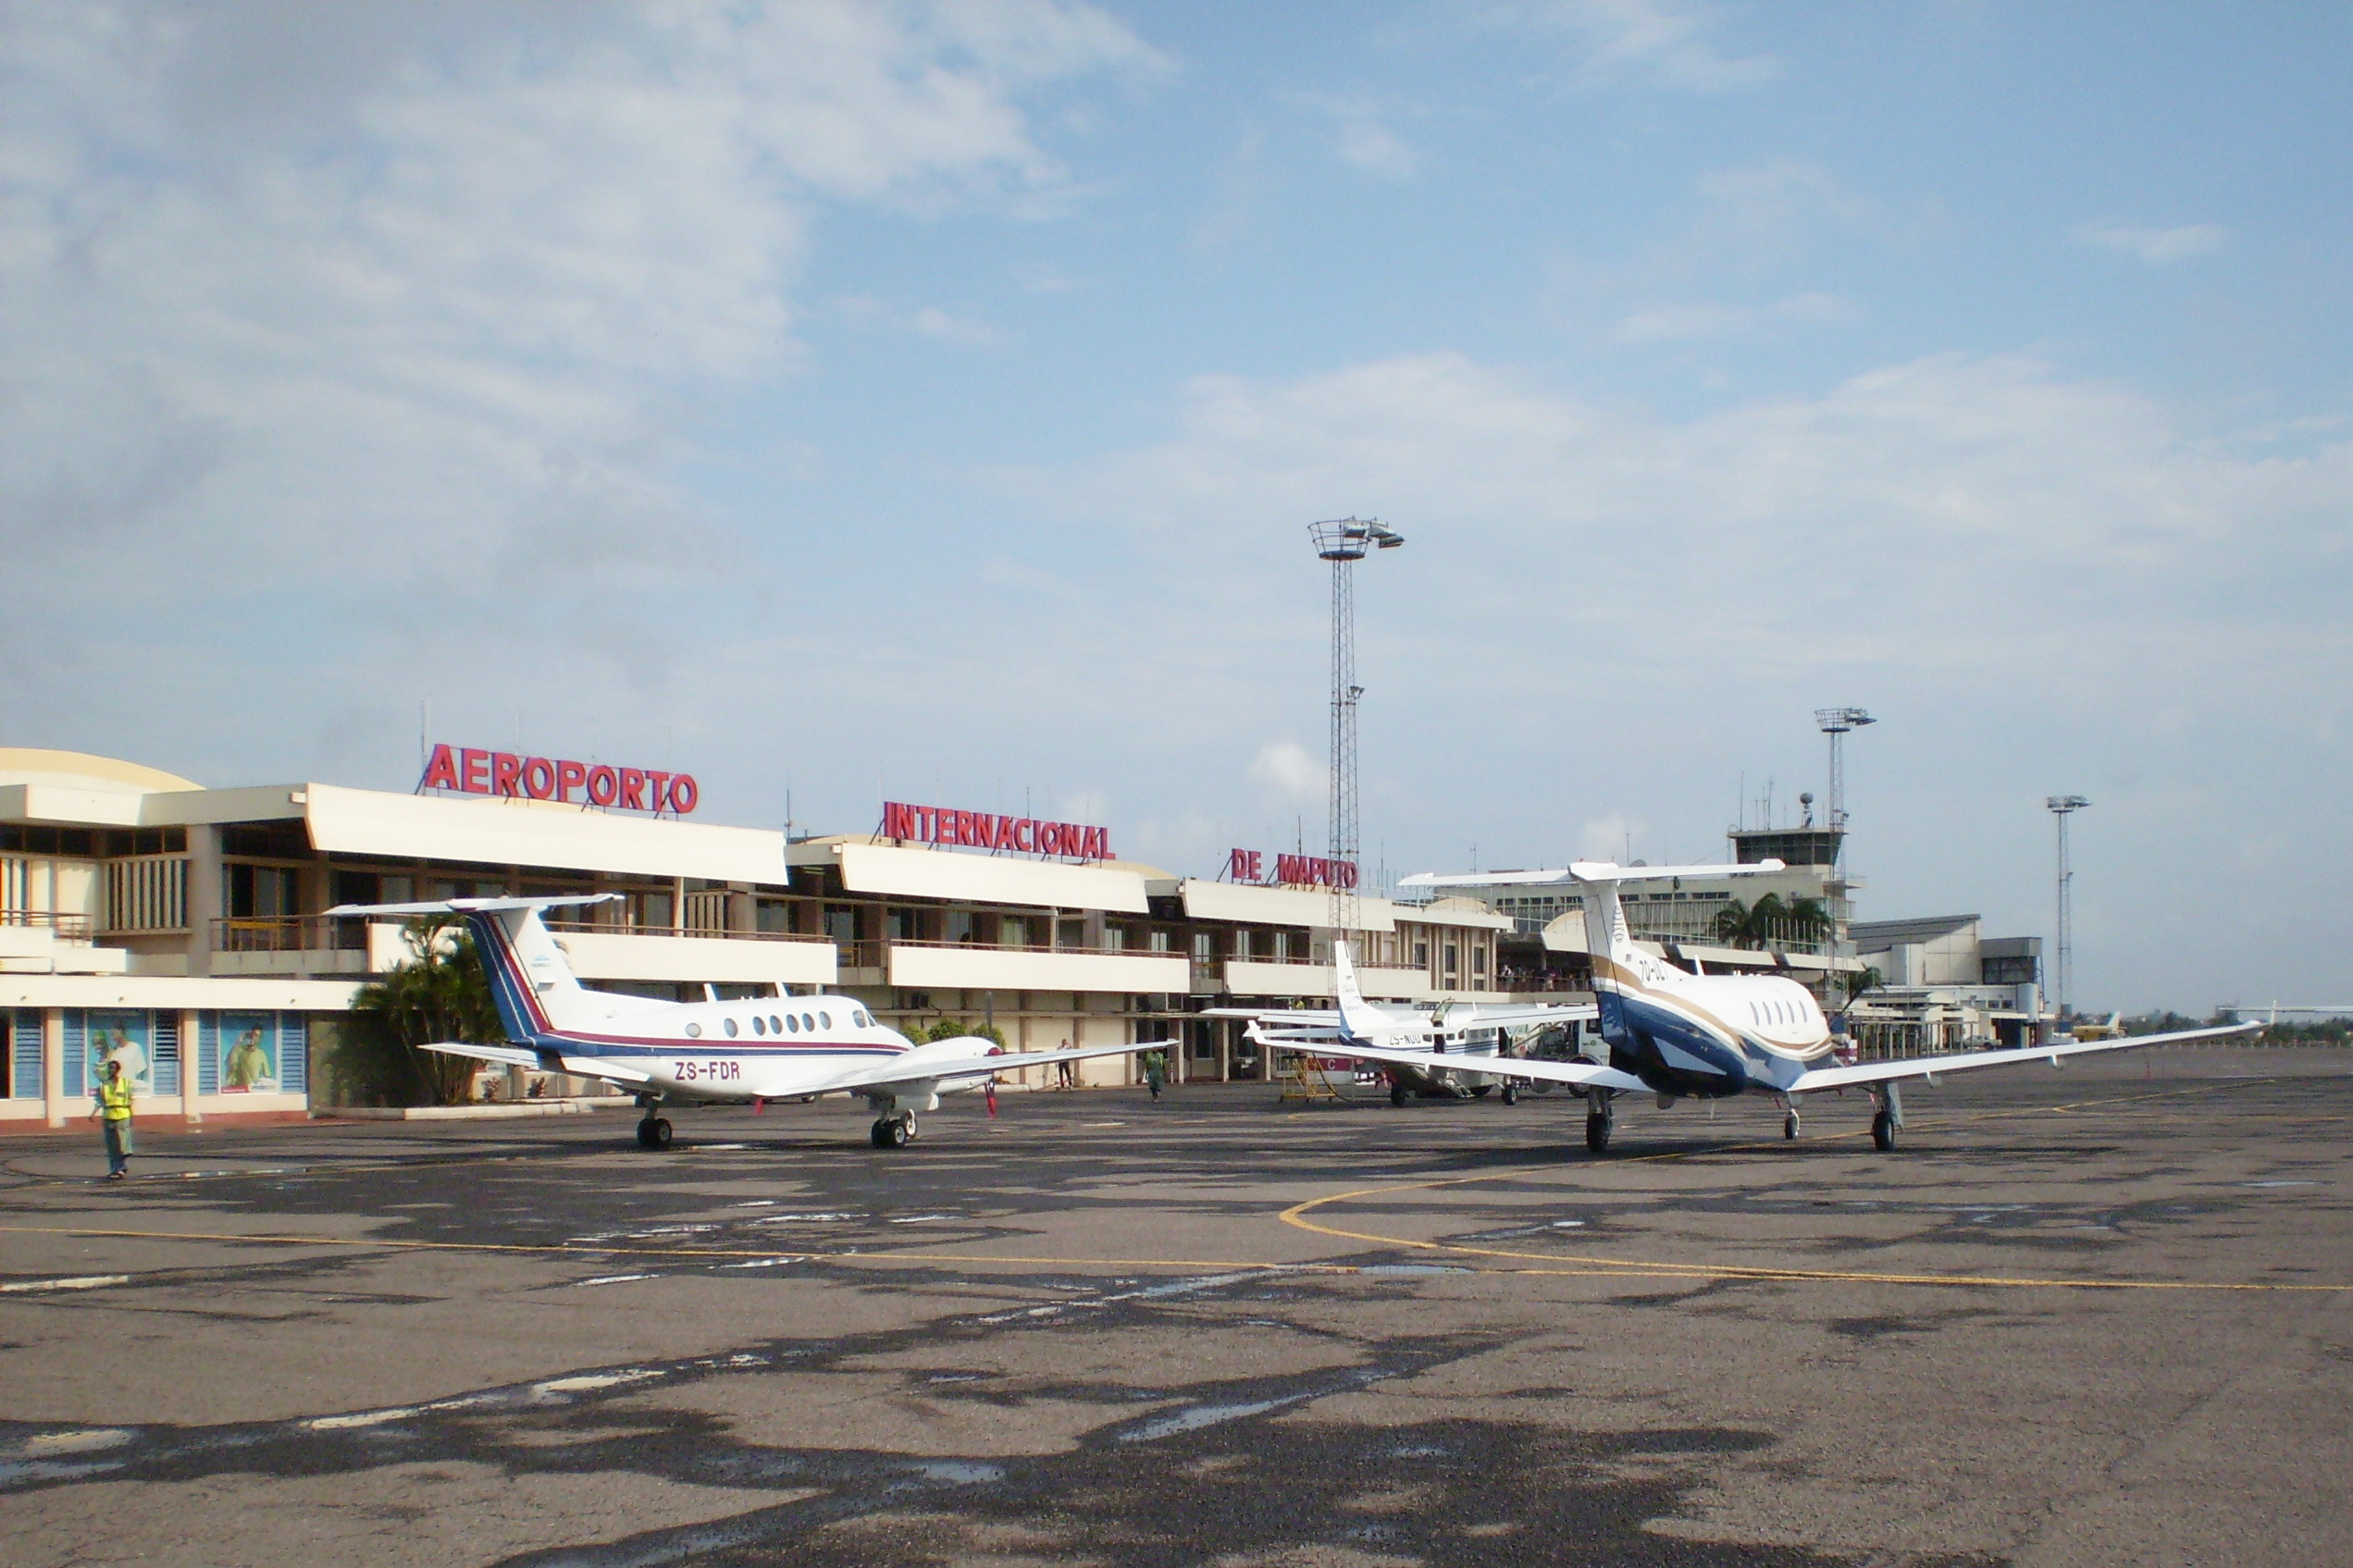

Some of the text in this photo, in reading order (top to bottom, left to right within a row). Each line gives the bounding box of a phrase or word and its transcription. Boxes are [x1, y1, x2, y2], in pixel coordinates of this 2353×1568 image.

[425, 743, 1358, 889] AEROPORTO INTERNACIONAL DE MAPUTO
[675, 1061, 740, 1080] ZS-FDR
[1327, 1058, 1336, 1070] C
